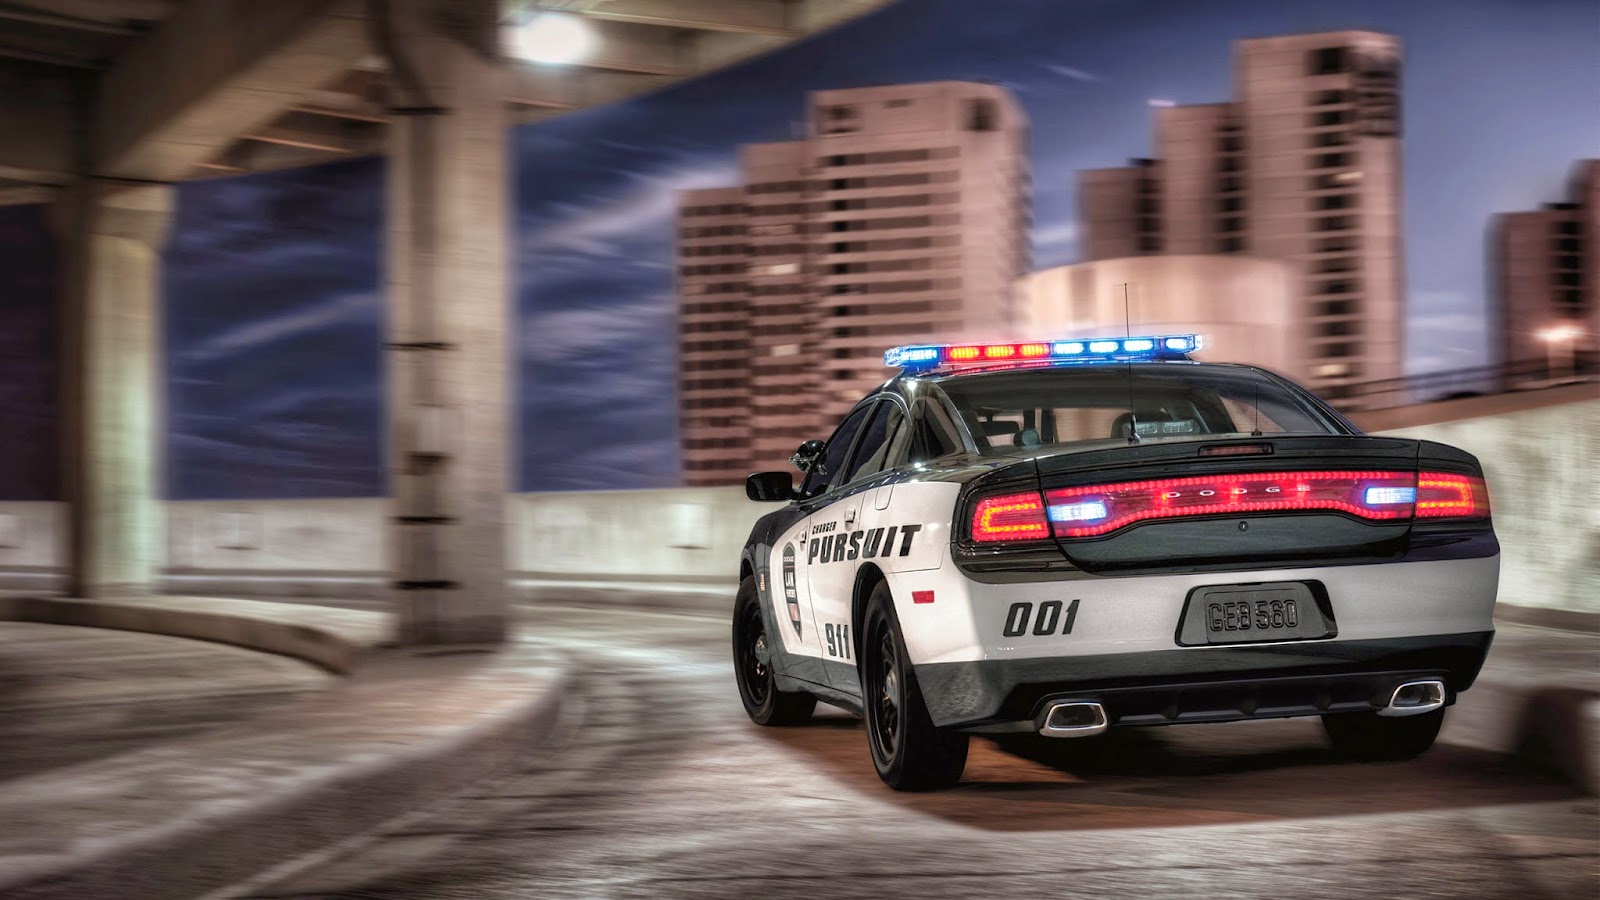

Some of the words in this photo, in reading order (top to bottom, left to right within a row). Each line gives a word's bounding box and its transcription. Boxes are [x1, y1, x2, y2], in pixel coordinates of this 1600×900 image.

[1165, 484, 1311, 498] DODGE
[808, 524, 922, 565] PURSUIT
[812, 521, 837, 535] CHARGER
[1003, 599, 1081, 637] 001
[1208, 601, 1251, 631] GEB
[1255, 600, 1298, 630] 560
[825, 623, 851, 660] 911
